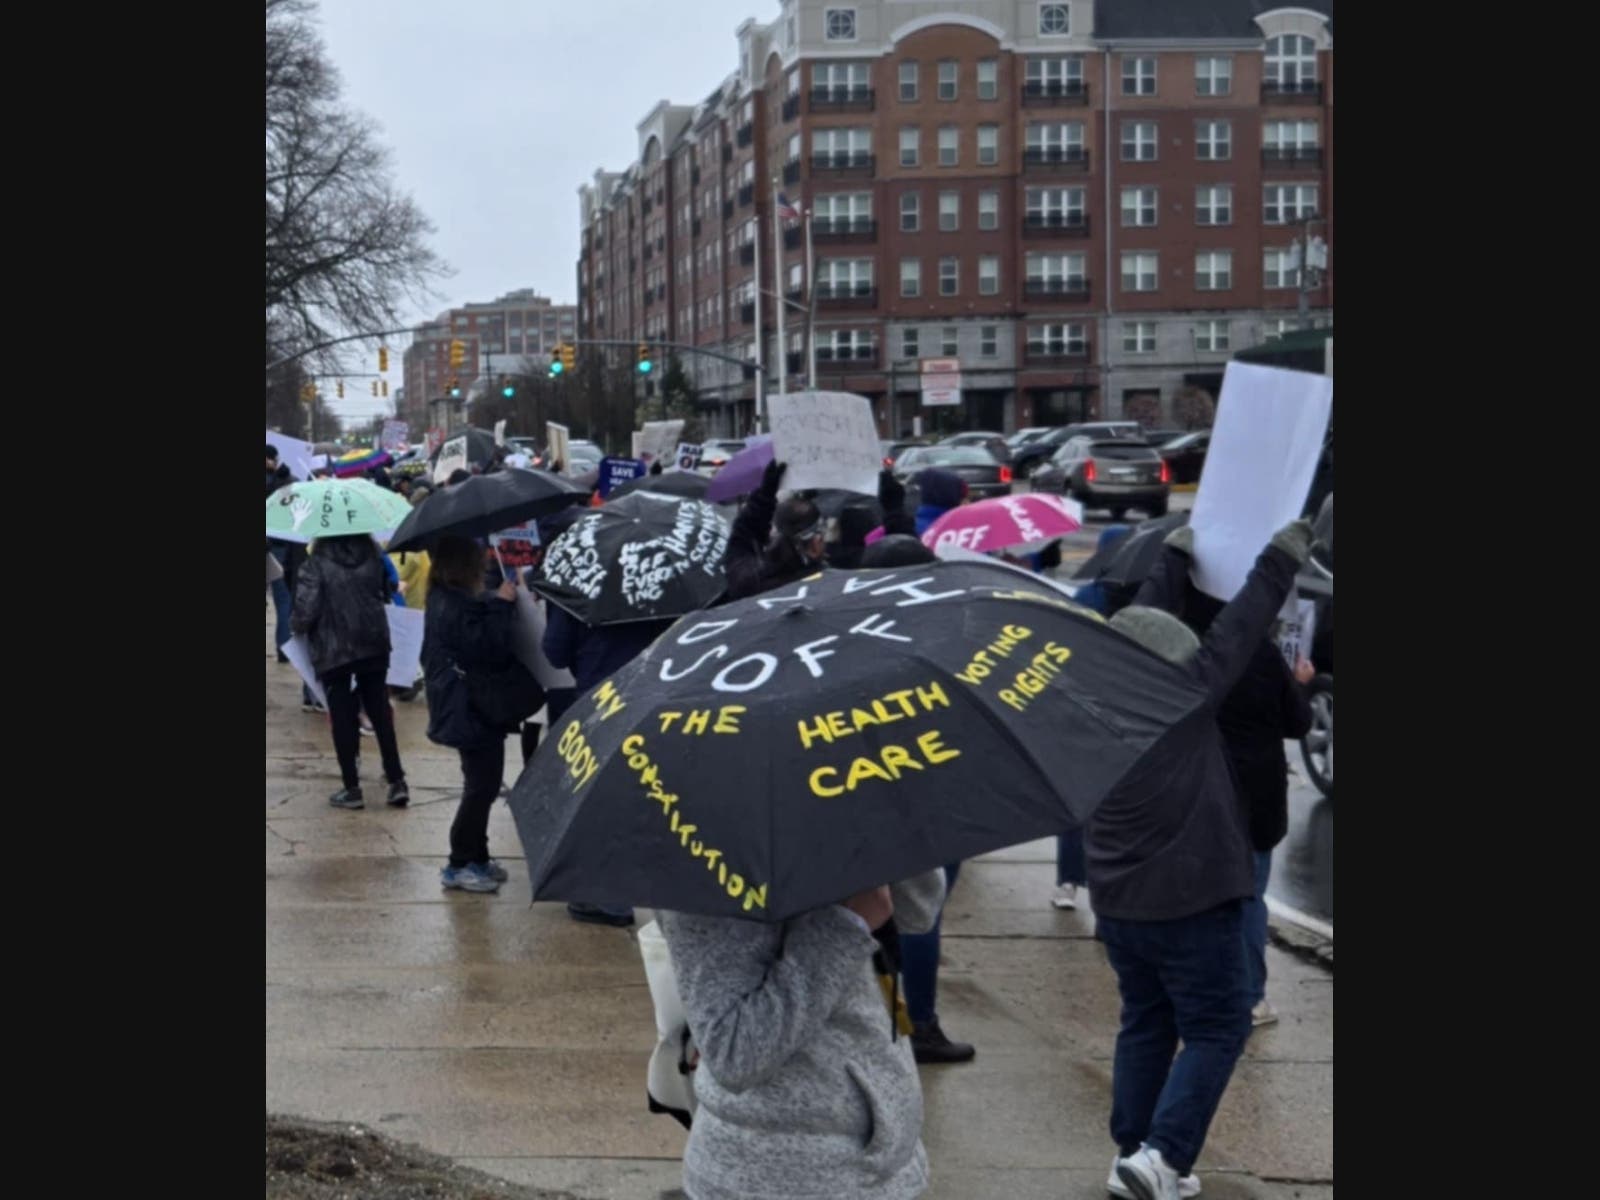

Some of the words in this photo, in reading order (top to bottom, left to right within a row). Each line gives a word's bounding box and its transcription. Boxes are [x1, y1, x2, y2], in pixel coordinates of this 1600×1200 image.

[611, 466, 635, 478] SAVE
[935, 525, 990, 549] OFF
[955, 624, 1032, 685] VOTING
[998, 641, 1072, 712] RIGHTS
[592, 681, 626, 721] MY
[659, 705, 747, 735] THE
[798, 681, 950, 749] HEALTH
[558, 720, 599, 793] BODY
[809, 730, 961, 797] CARE
[622, 735, 767, 911] CONSTITUTION
